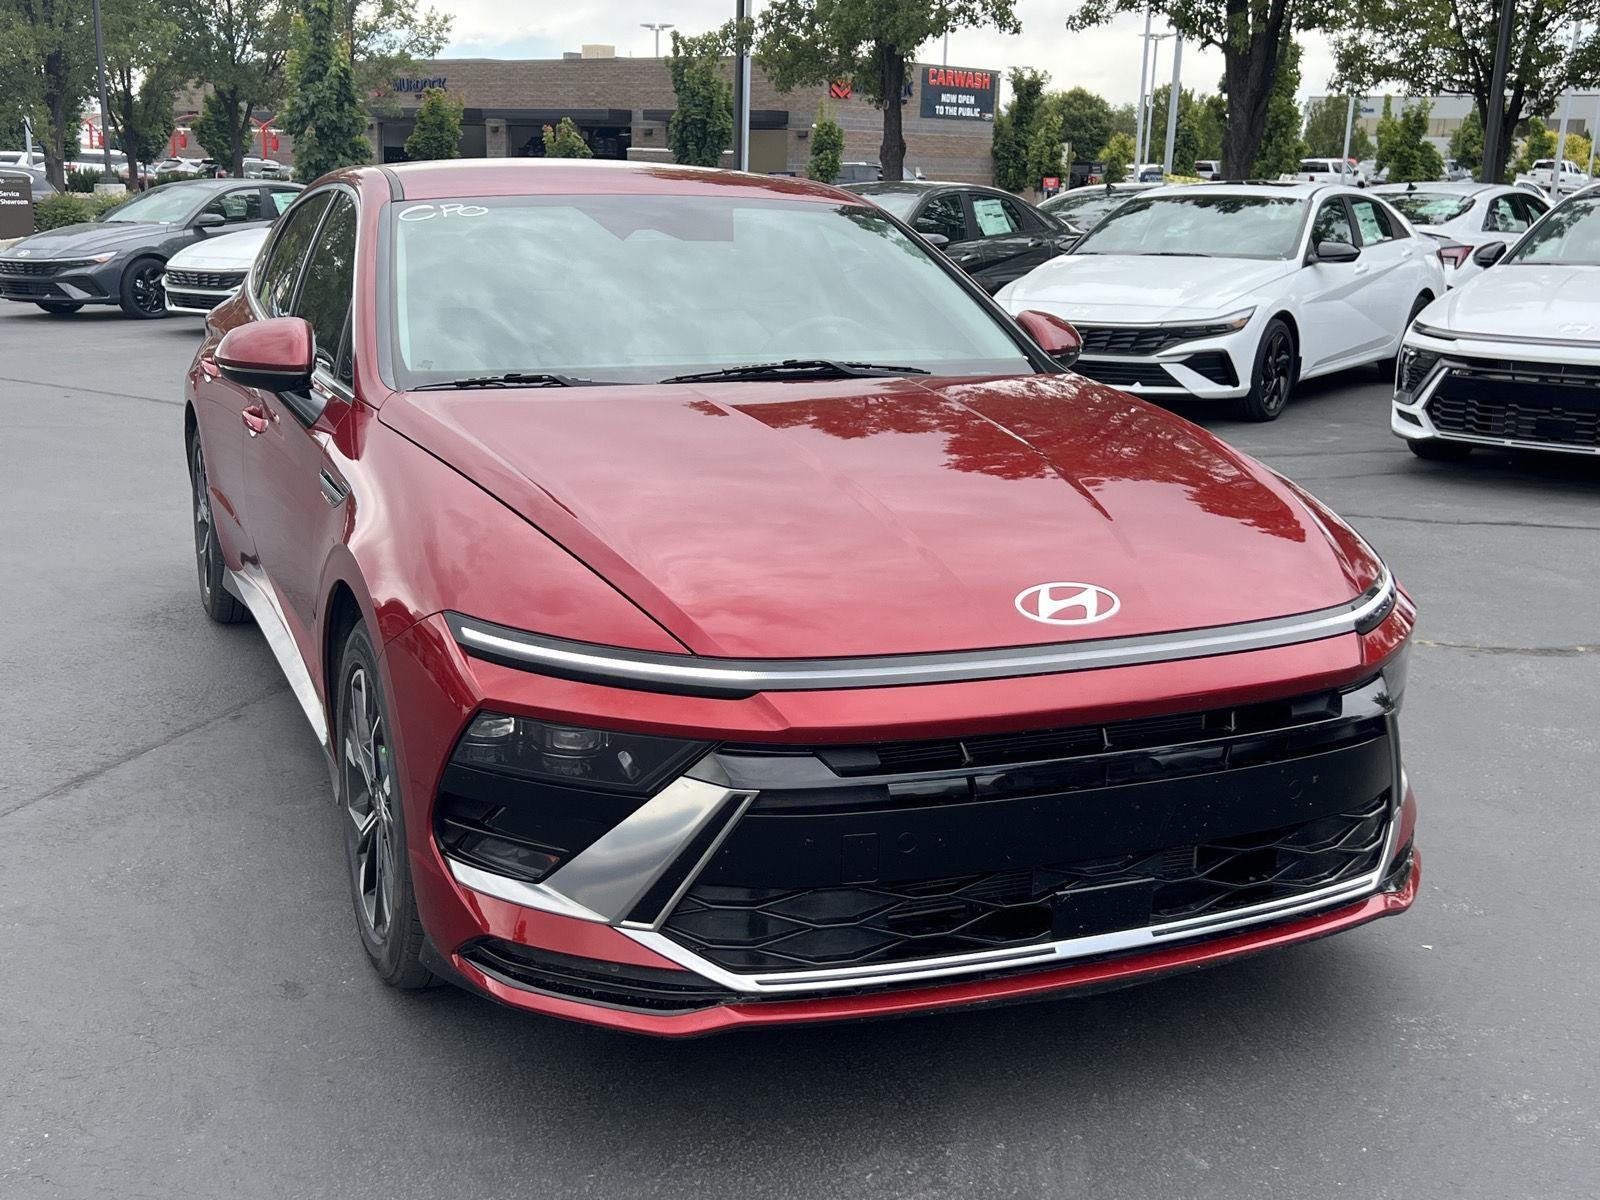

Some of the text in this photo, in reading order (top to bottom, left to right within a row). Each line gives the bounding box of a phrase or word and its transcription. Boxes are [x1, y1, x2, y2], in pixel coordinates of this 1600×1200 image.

[928, 68, 991, 90] CARWASH
[941, 93, 975, 104] NOW OPEN
[935, 105, 944, 115] TO
[945, 106, 957, 116] THE
[958, 107, 981, 117] PUBLIC
[398, 203, 489, 222] CPO
